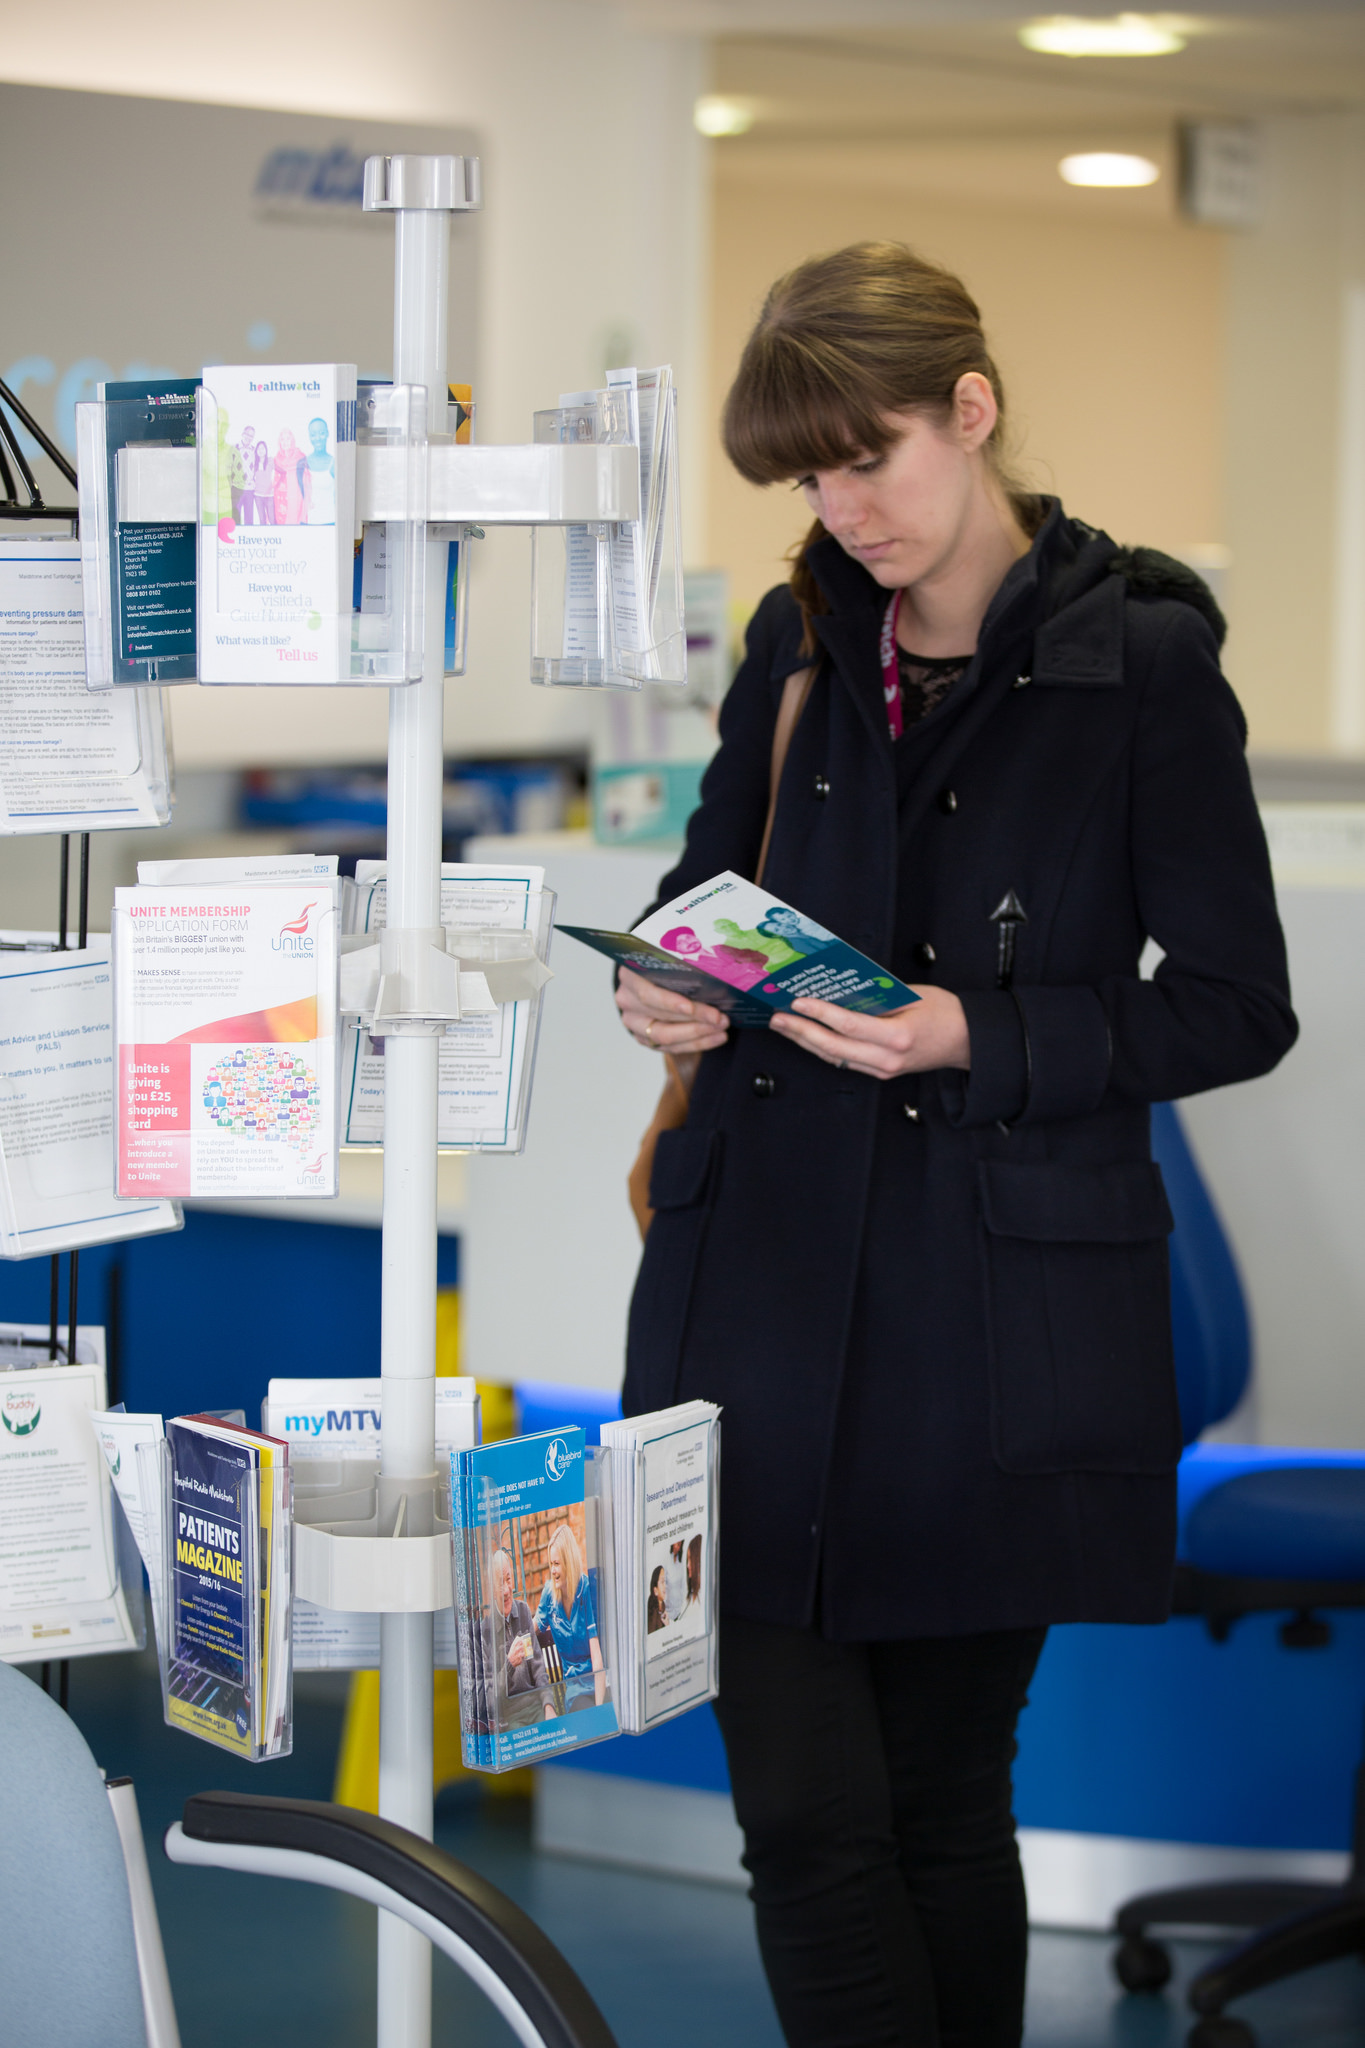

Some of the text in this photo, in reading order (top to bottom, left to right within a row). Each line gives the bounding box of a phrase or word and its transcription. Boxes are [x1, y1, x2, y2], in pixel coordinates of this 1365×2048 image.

[249, 381, 321, 392] healthwatch
[238, 536, 281, 545] Have you
[217, 547, 278, 560] seen your
[229, 560, 307, 575] GP recently?
[248, 583, 292, 593] Have you
[33, 611, 65, 619] pressure
[216, 635, 291, 645] What was it like?
[276, 649, 318, 661] Tell us
[675, 882, 733, 915] healthwatch
[130, 905, 251, 917] UNITE MEMBERSHIP
[212, 919, 249, 931] FORM
[145, 935, 173, 943] Britain's
[174, 935, 208, 943] BIGGEST
[209, 935, 229, 943] union
[229, 935, 244, 943] with
[272, 935, 314, 951] unite
[181, 946, 204, 955] people
[205, 946, 218, 955] just
[218, 945, 231, 953] like
[231, 946, 247, 955] you.
[789, 972, 807, 983] you
[803, 963, 826, 975] have
[786, 971, 829, 993] something
[12, 1034, 36, 1042] Advice
[38, 1032, 52, 1041] and
[52, 1028, 80, 1038] Liaison
[81, 1023, 110, 1034] Service
[35, 1040, 62, 1053] (PALS)
[34, 1066, 42, 1075] to
[66, 1059, 93, 1070] matters
[94, 1057, 102, 1065] to
[128, 1063, 170, 1073] Unite is
[128, 1077, 162, 1090] giving
[128, 1091, 171, 1103] you £25
[128, 1104, 178, 1118] shopping
[128, 1118, 151, 1129] card
[157, 1139, 173, 1148] you
[127, 1149, 166, 1158] introduce
[145, 1160, 178, 1169] member
[138, 1172, 161, 1182] Unite
[297, 1174, 326, 1185] unite
[6, 1400, 35, 1410] buddy
[557, 1449, 582, 1463] bluebird
[518, 1480, 527, 1489] NOT
[527, 1478, 538, 1487] HAVE
[675, 1474, 704, 1492] Development
[504, 1493, 520, 1504] OPTION
[660, 1494, 687, 1511] Department
[179, 1511, 240, 1555] PATIENTS
[176, 1538, 243, 1585] MAGAZINE
[198, 1573, 221, 1591] 2015/16
[236, 1713, 247, 1731] FREE
